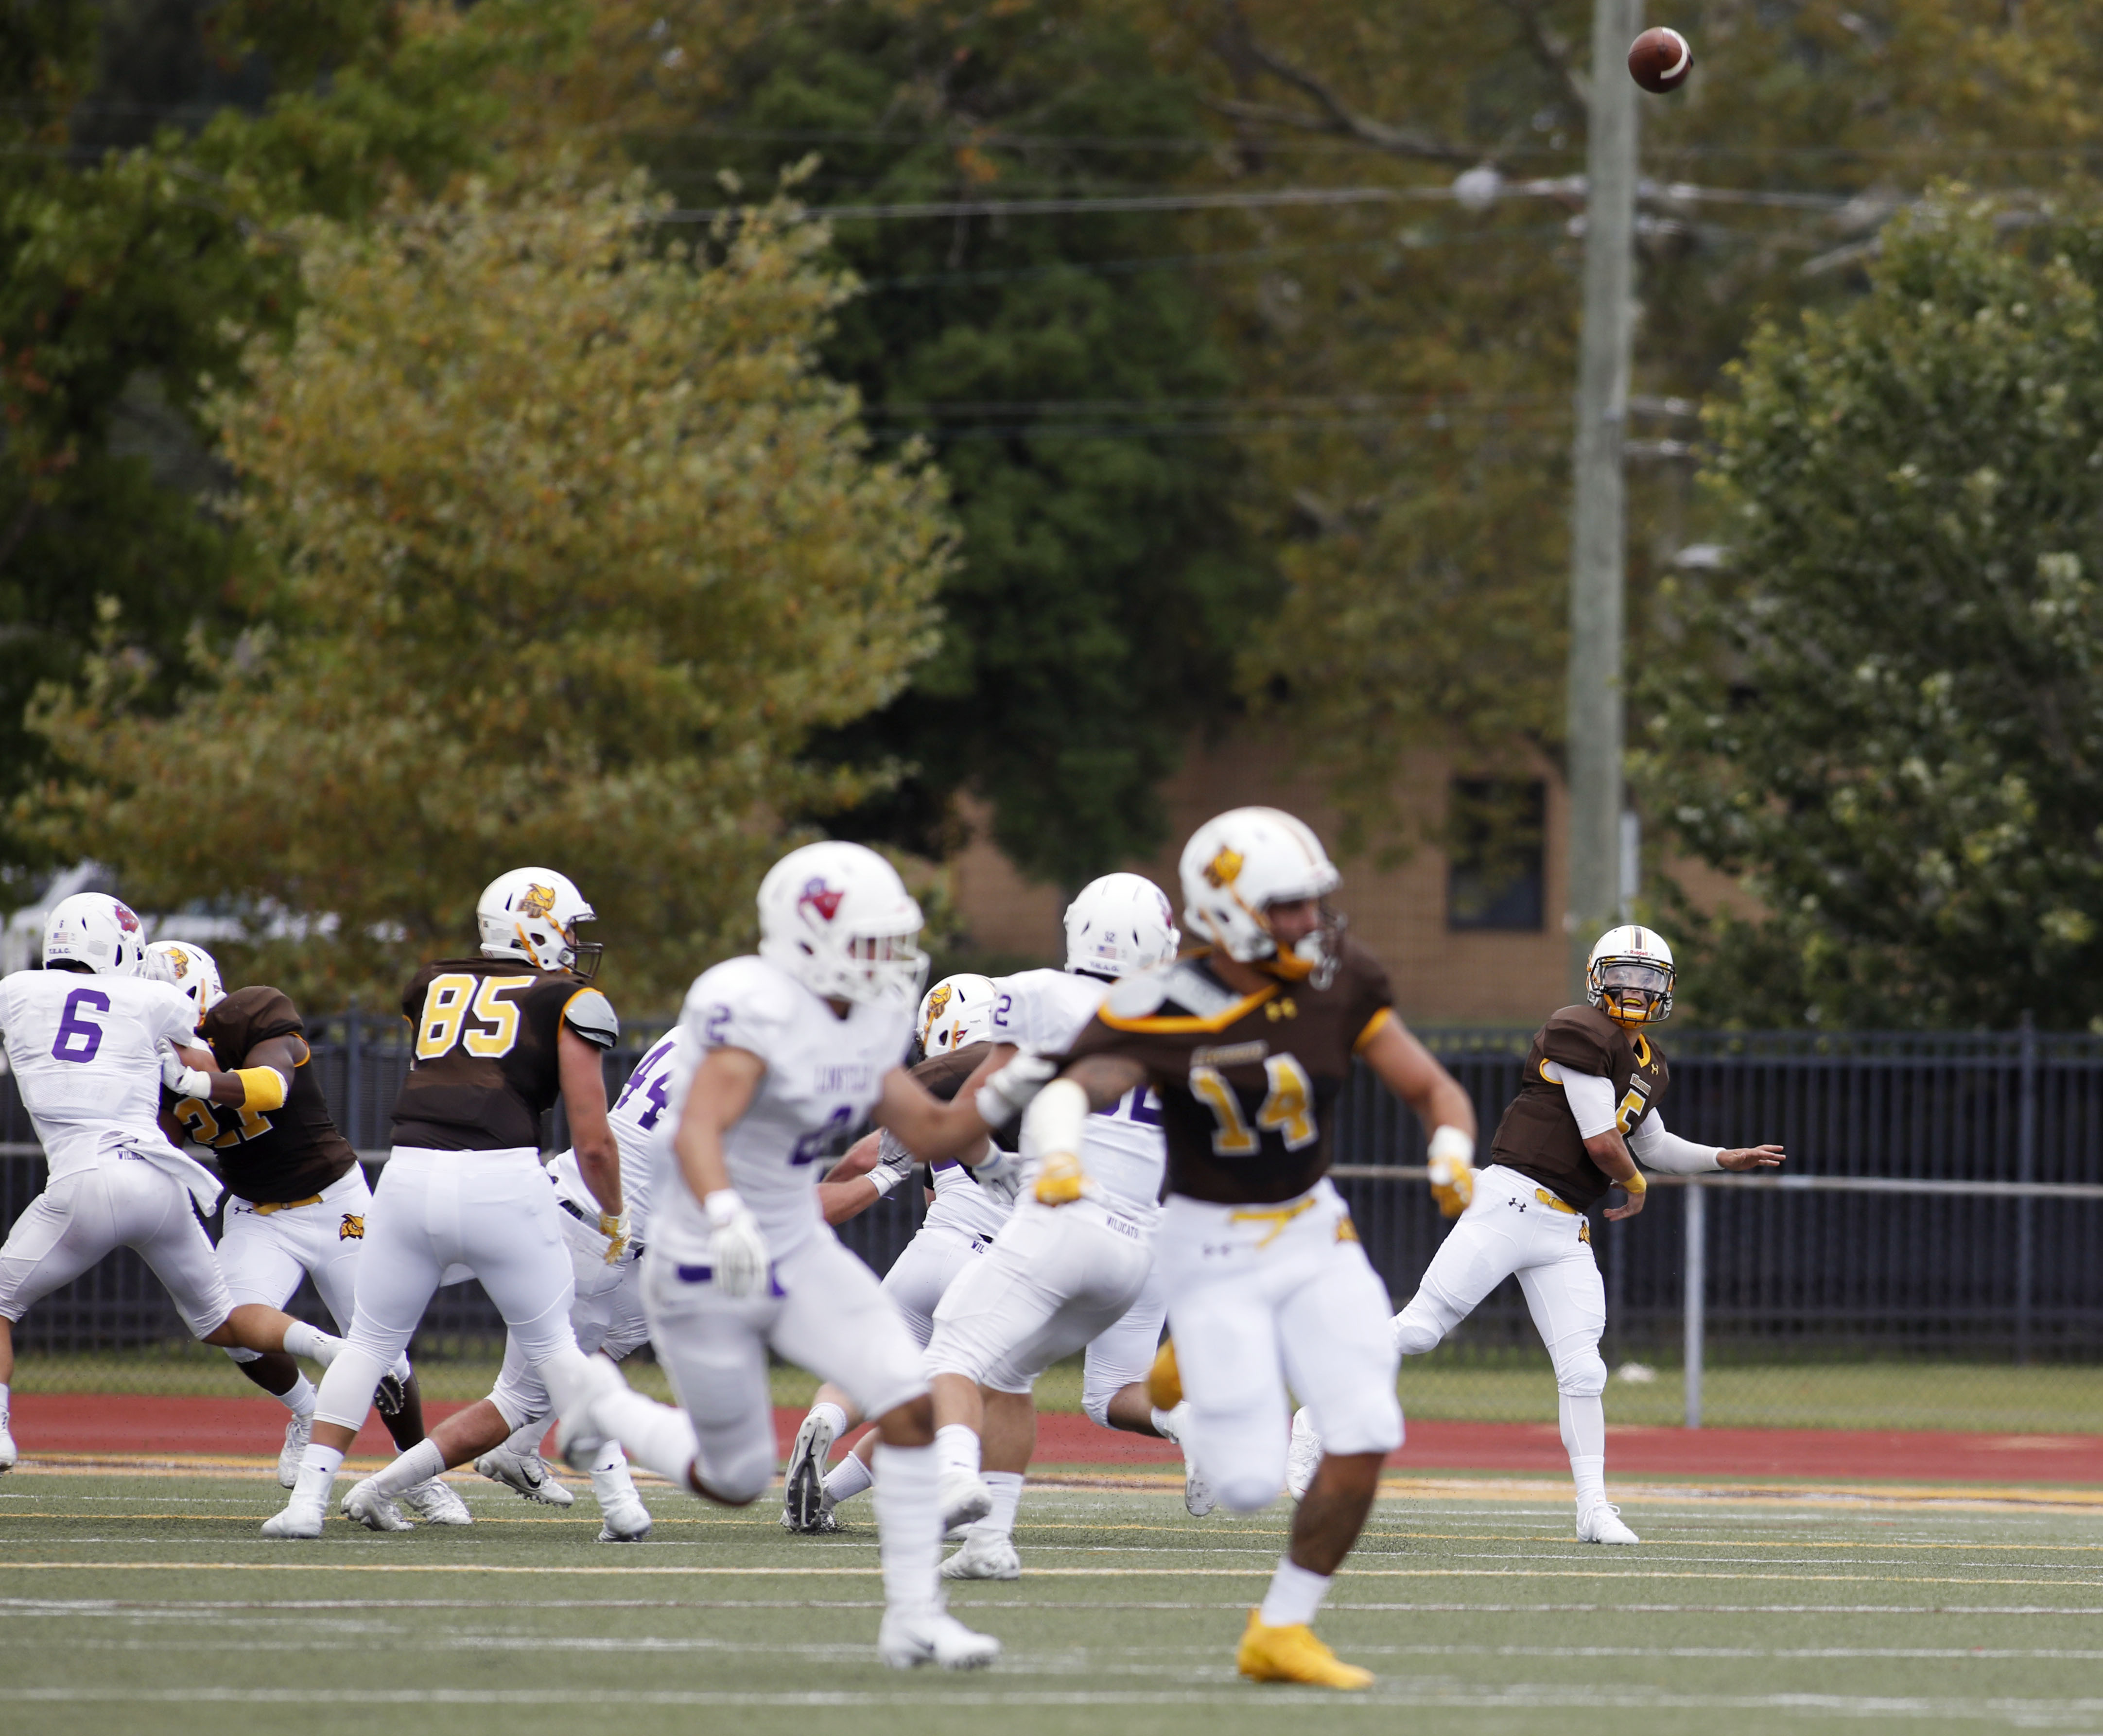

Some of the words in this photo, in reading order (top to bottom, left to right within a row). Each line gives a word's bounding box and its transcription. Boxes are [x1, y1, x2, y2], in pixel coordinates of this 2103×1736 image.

[51, 988, 111, 1063] 6
[415, 973, 537, 1060] 85
[705, 1003, 730, 1044] 2
[1189, 1051, 1319, 1157] 14
[1107, 1215, 1140, 1239] WILDCATS
